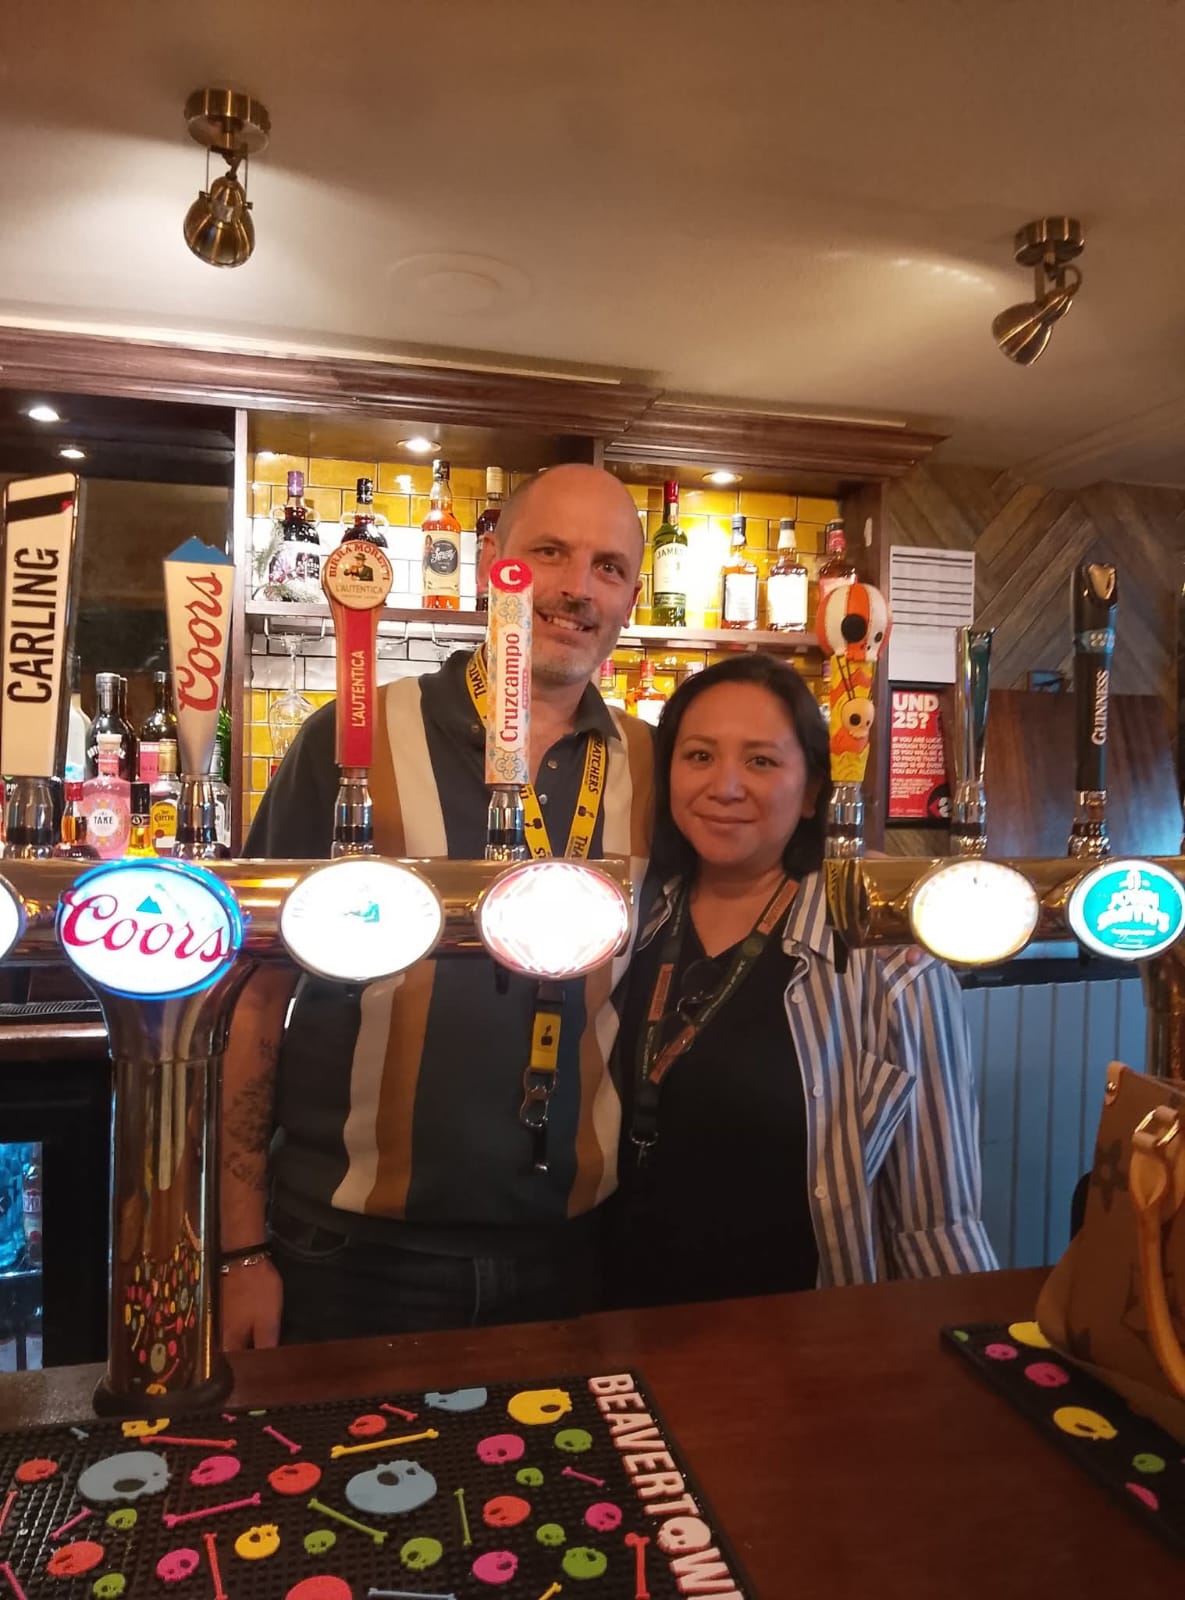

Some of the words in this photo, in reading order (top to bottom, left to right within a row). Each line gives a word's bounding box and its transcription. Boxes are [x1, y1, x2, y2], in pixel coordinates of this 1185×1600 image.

[7, 548, 59, 704] CARLING
[176, 571, 224, 713] Coors
[351, 650, 366, 728] L'AUTENTICA
[499, 632, 522, 743] Cruzcampo
[892, 693, 939, 712] UND
[892, 711, 930, 730] 25?
[1091, 670, 1110, 746] GUINNESS
[589, 740, 603, 794] HATCHERS
[60, 888, 231, 963] Coors
